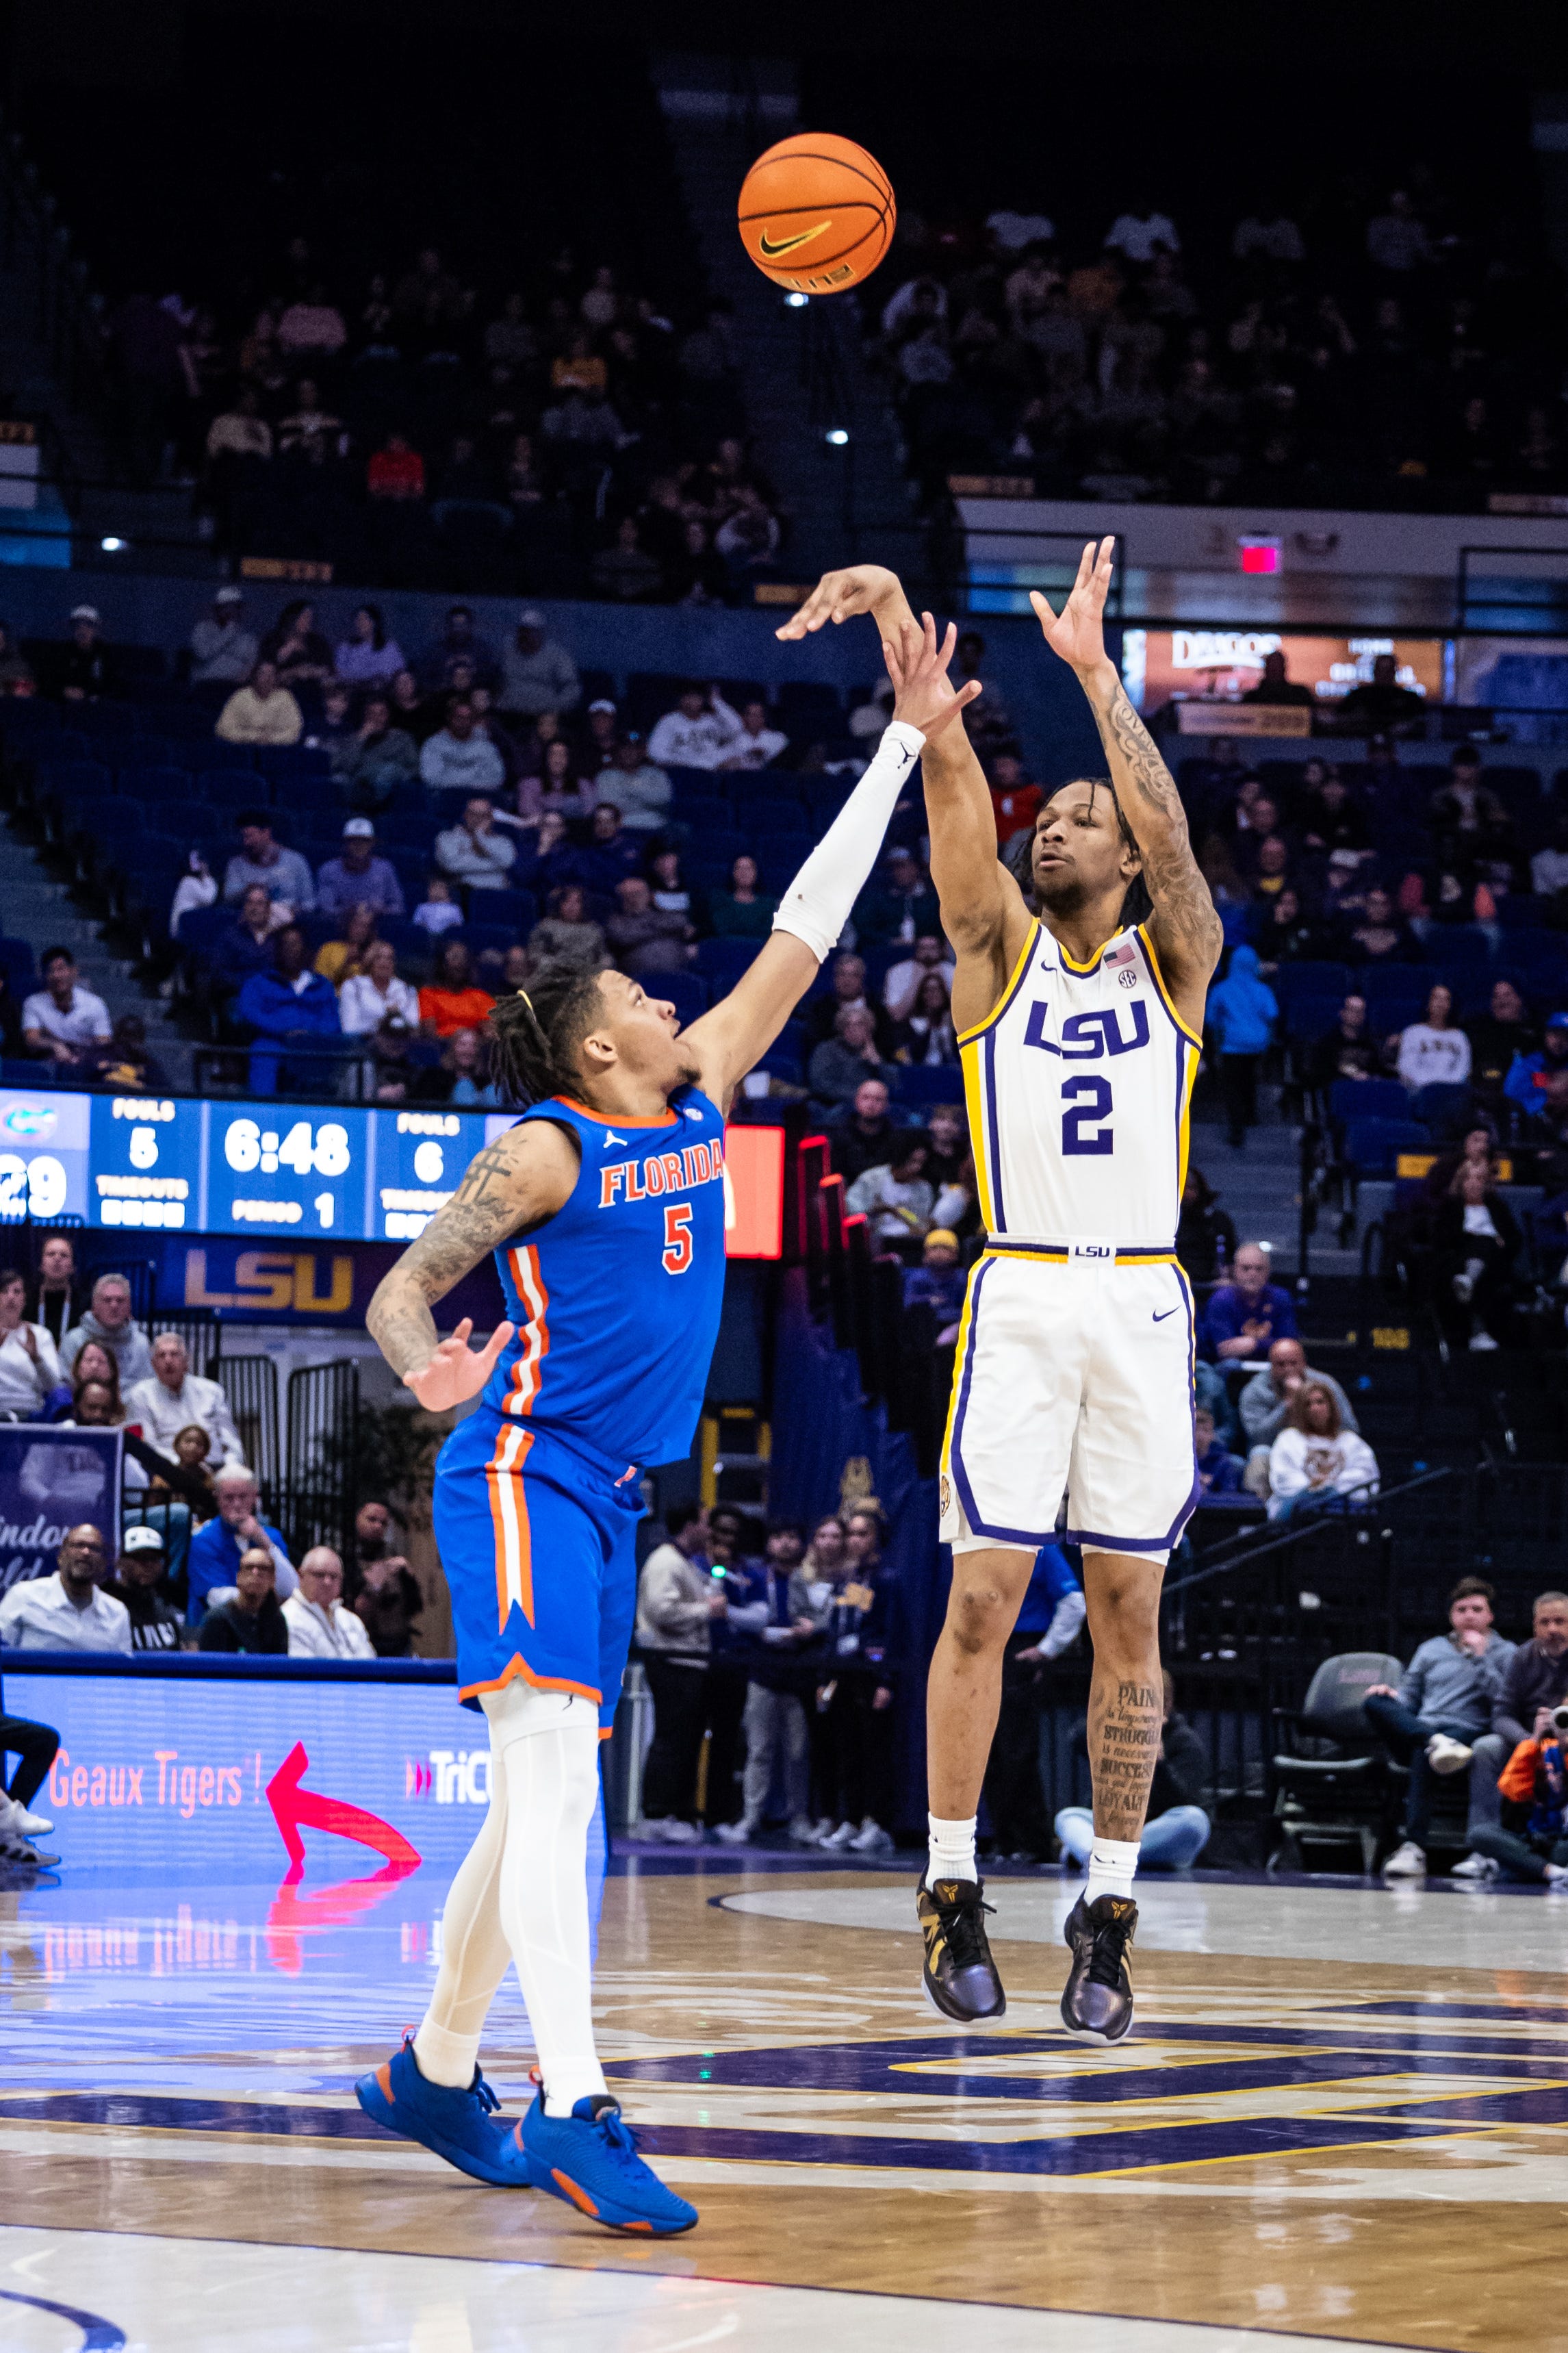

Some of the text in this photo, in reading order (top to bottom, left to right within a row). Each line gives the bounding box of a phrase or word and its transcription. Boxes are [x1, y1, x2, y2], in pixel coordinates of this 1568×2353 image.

[1023, 1000, 1150, 1059] LSU
[1061, 1075, 1114, 1155] 2
[224, 1119, 350, 1176] 6:48
[414, 1141, 444, 1183] 6
[598, 1138, 723, 1208] FLORIDA
[314, 1193, 335, 1228] 1
[662, 1202, 693, 1275] 5
[184, 1248, 353, 1312] LSU
[1075, 1245, 1109, 1257] LSU
[1118, 1683, 1155, 1707] PAIN
[49, 1748, 143, 1807] Geaux
[155, 1751, 242, 1818] Tigers
